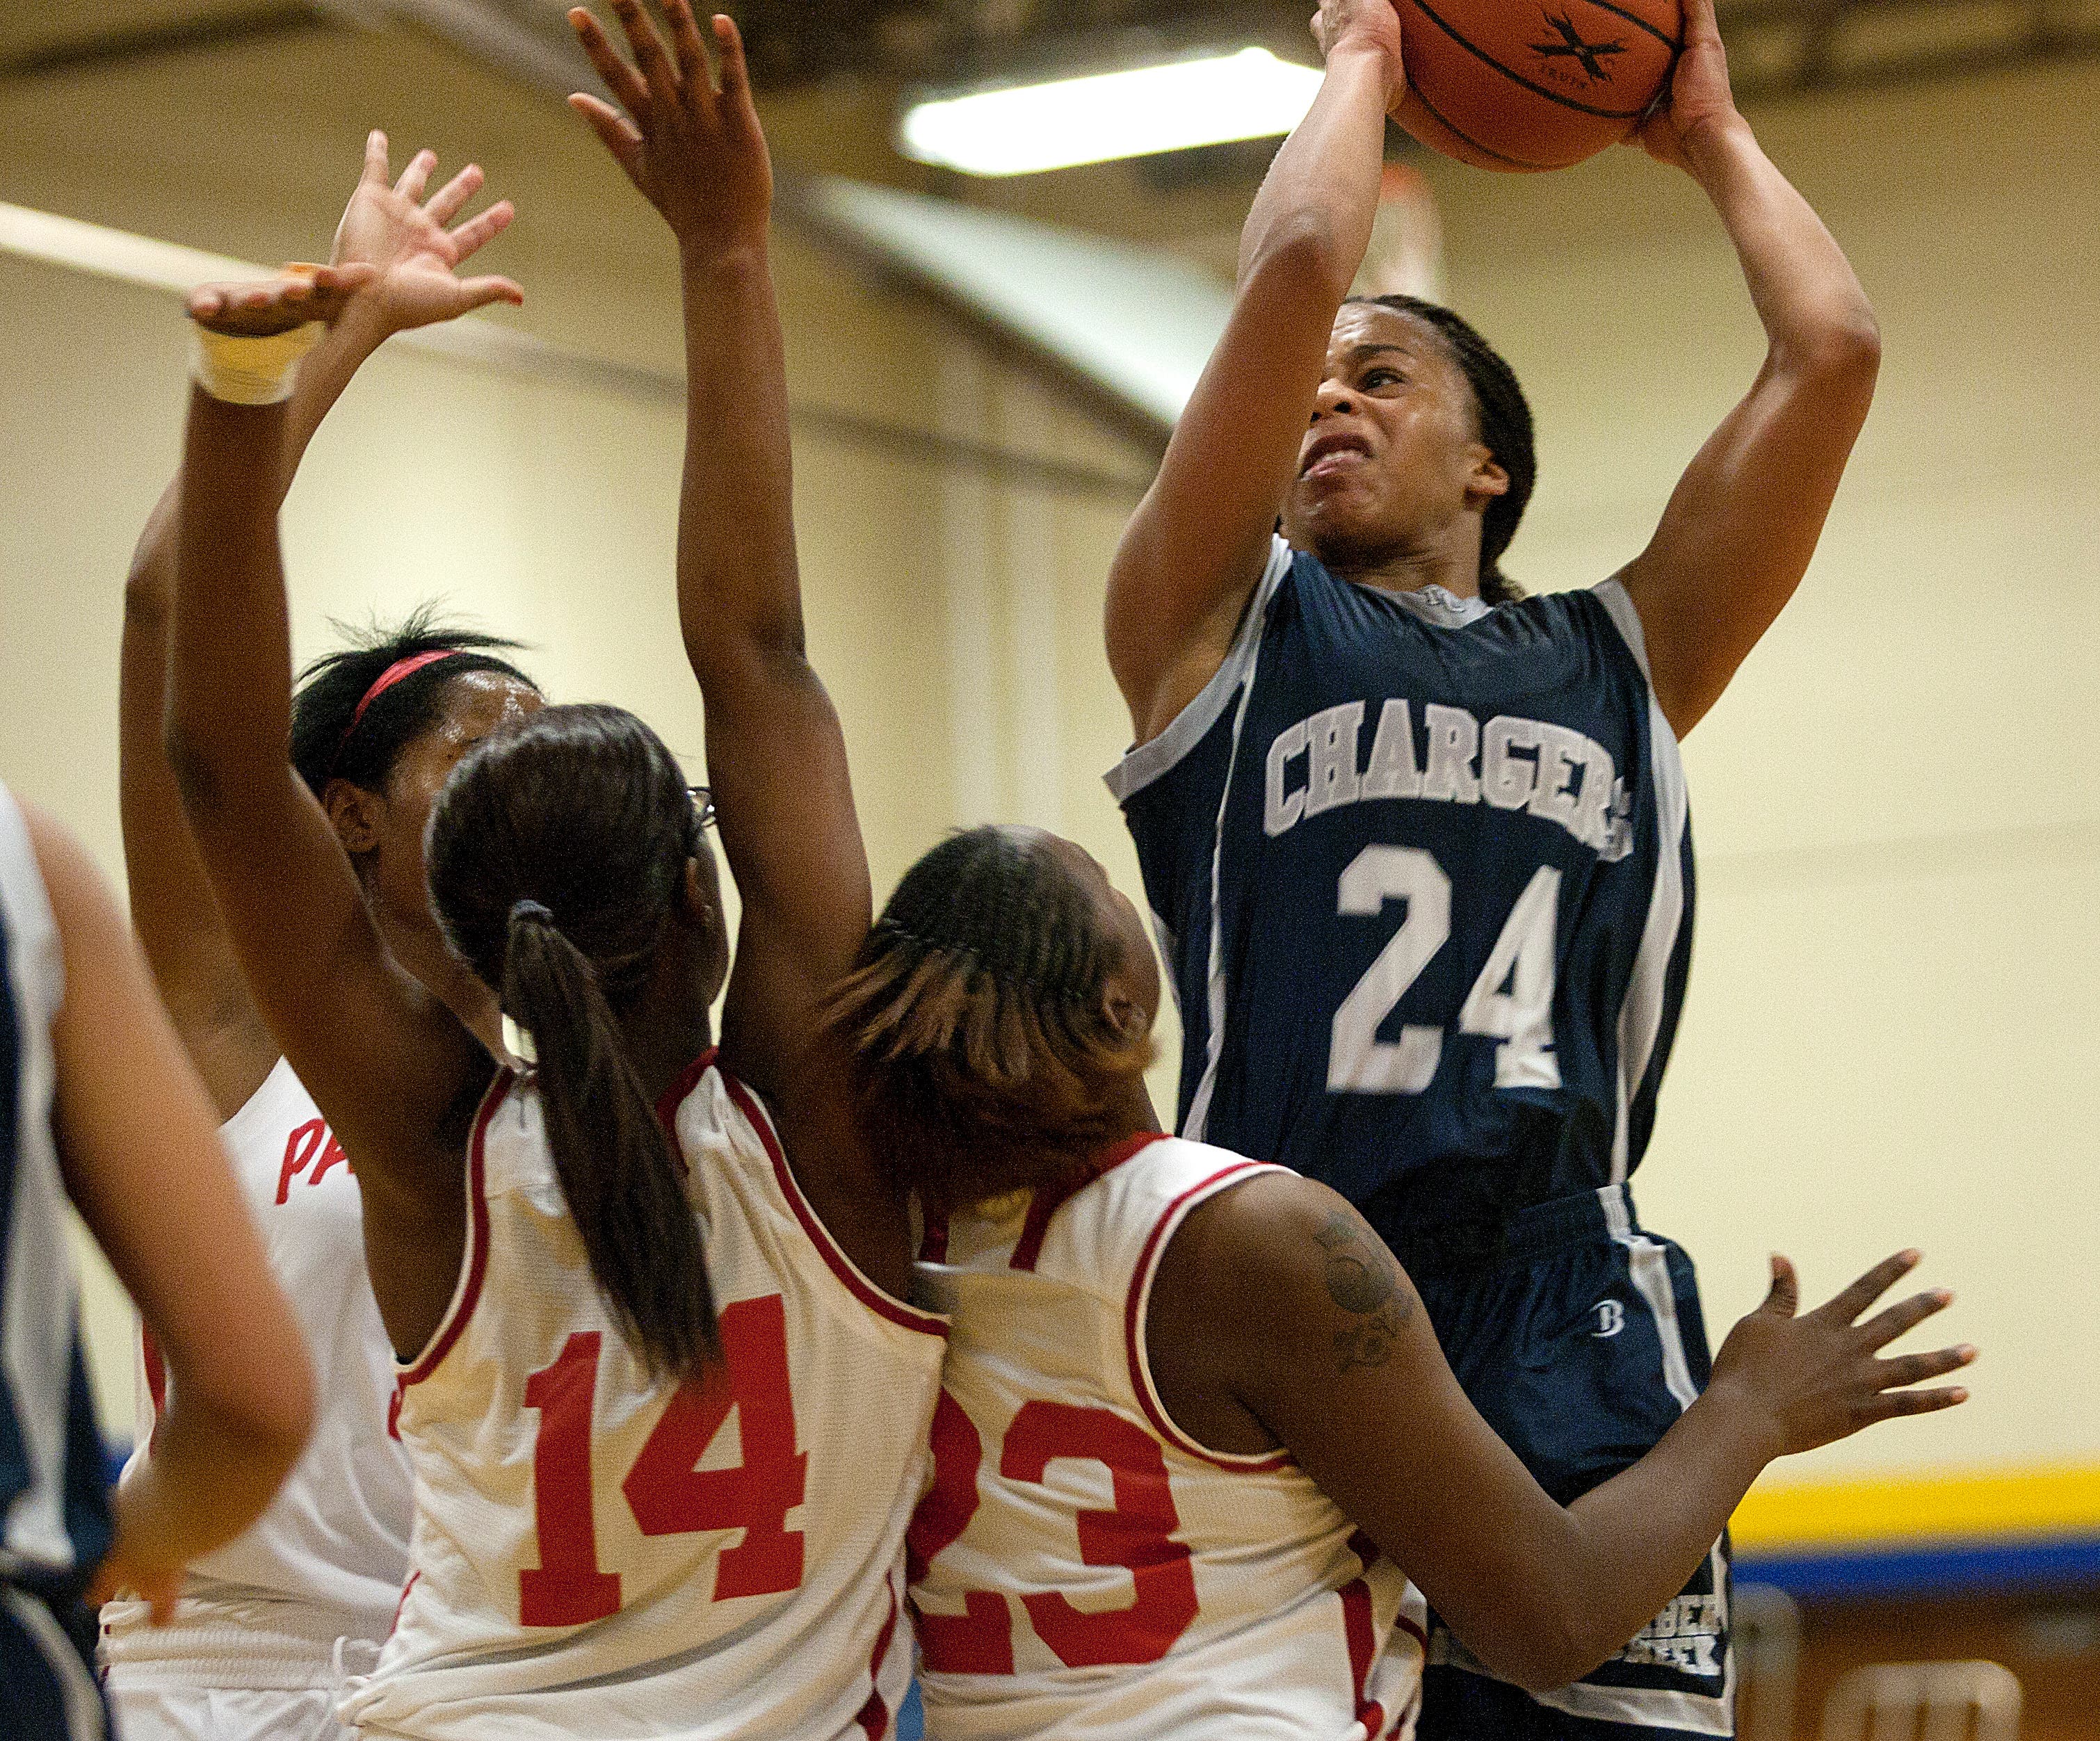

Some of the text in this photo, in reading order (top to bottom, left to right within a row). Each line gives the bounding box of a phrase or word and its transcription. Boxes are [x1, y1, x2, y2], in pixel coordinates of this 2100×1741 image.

[1326, 843, 1565, 1095] 24
[519, 1293, 808, 1627] 14
[1632, 1594, 1723, 1639] BER
